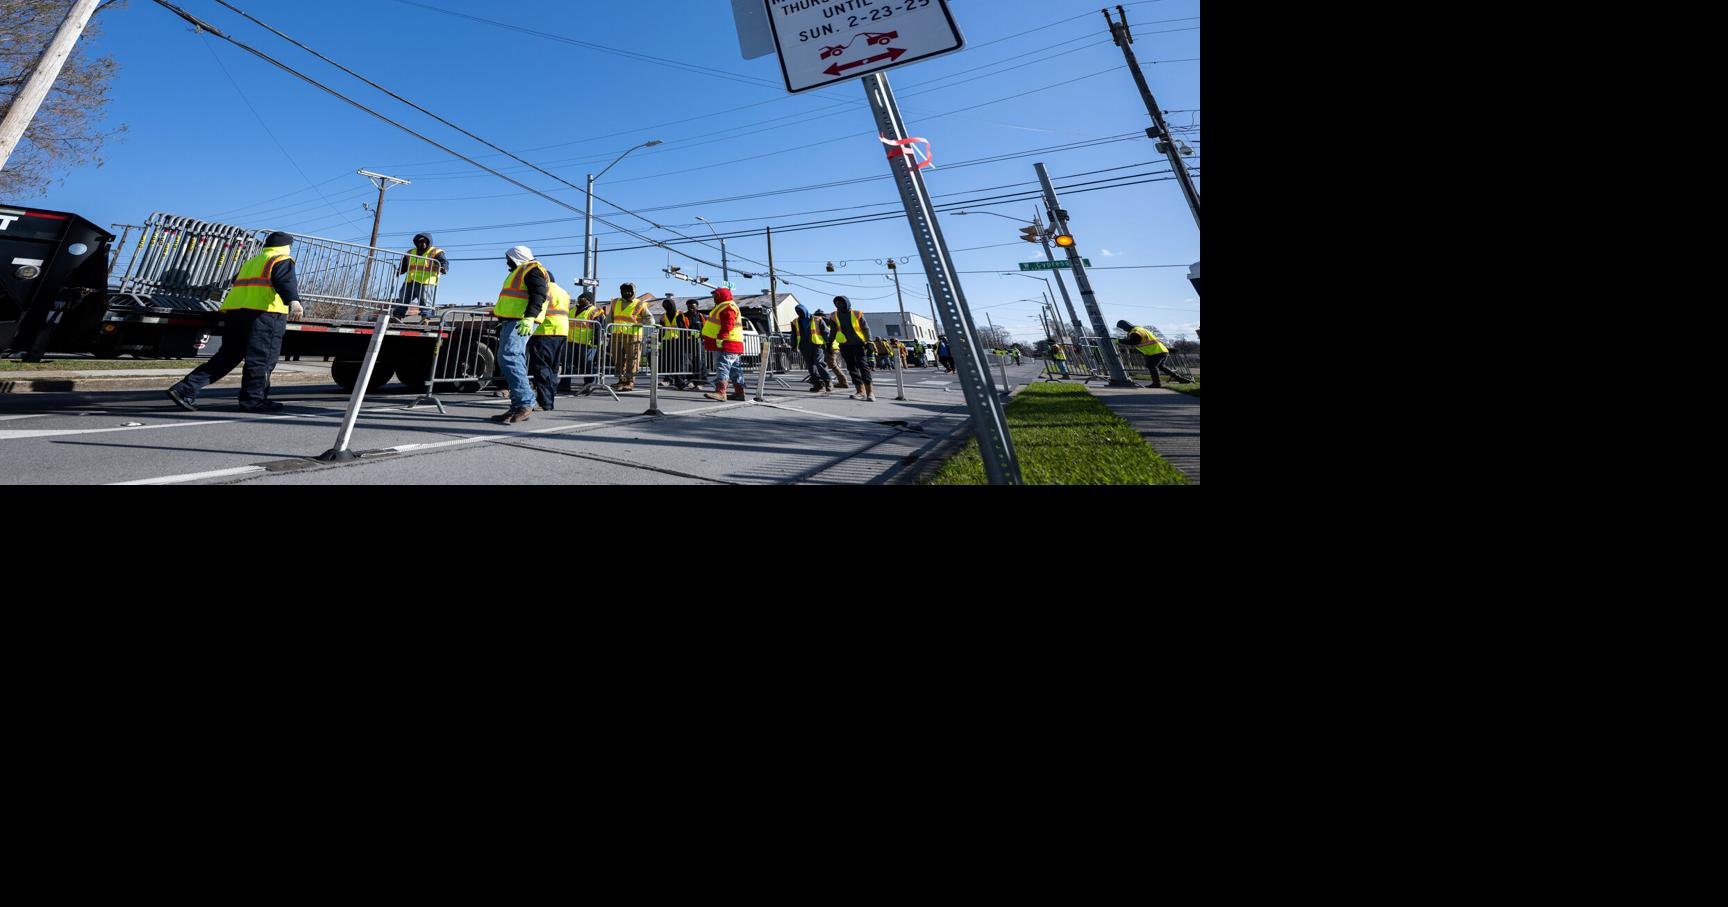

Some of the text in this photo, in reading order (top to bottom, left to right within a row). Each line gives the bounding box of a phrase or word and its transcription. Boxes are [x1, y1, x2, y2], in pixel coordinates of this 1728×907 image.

[781, 0, 829, 16] THUR
[822, 0, 873, 18] UNTIL
[799, 0, 930, 42] SUN. 2-23-25
